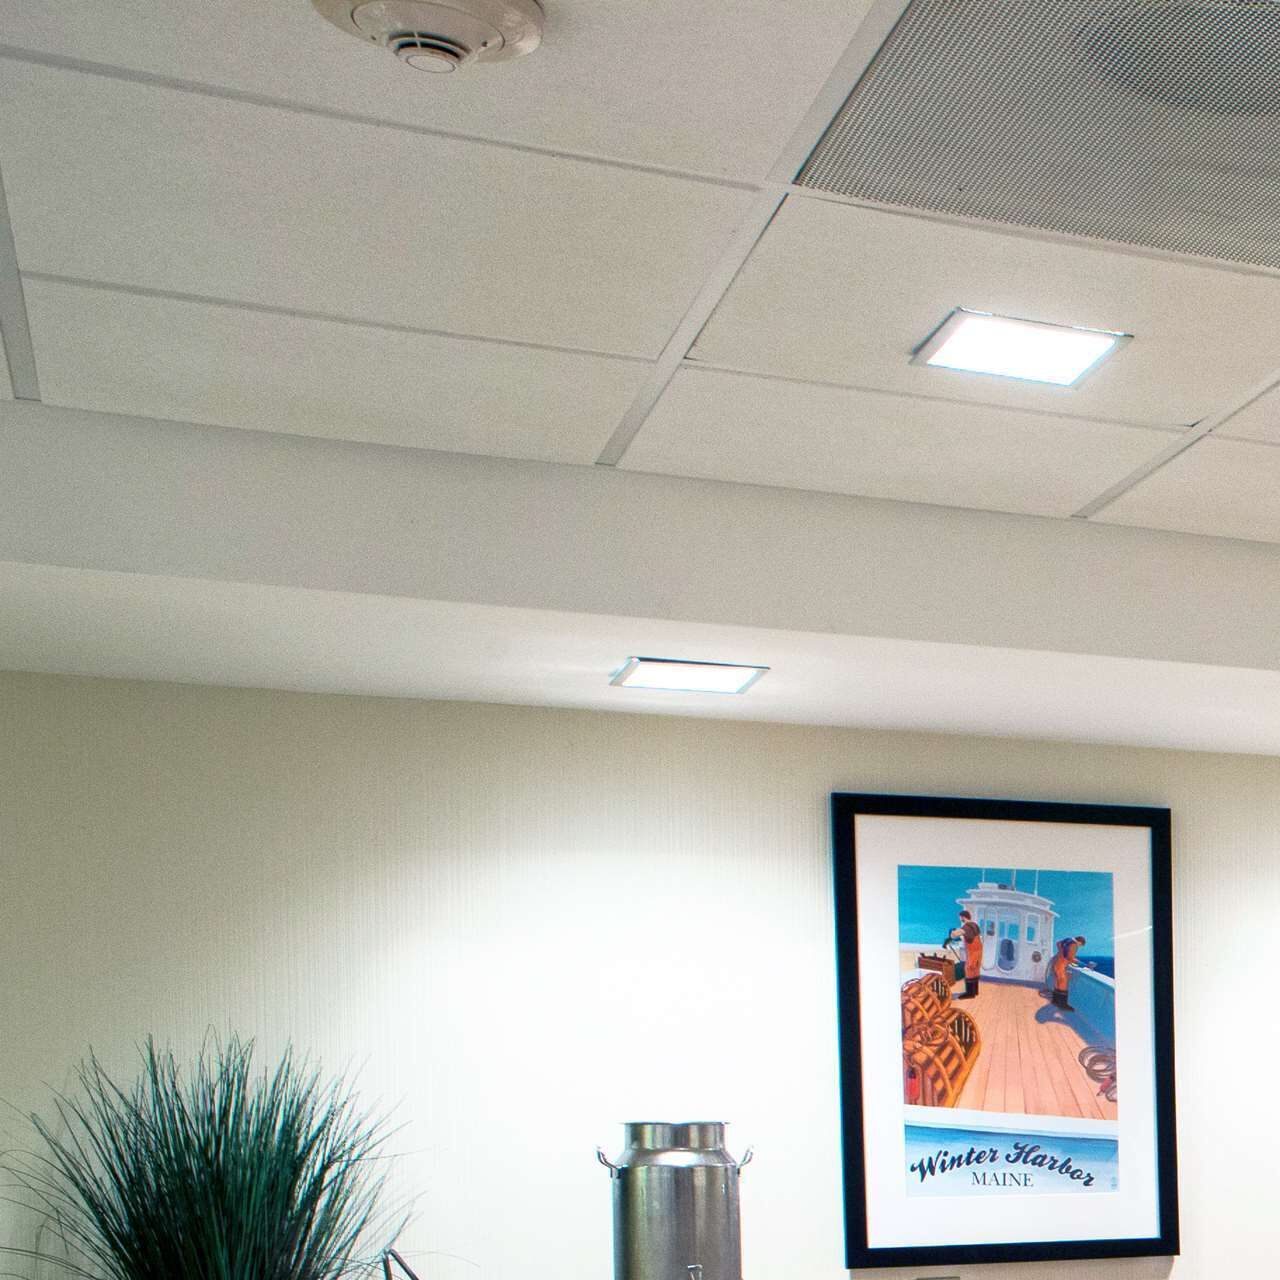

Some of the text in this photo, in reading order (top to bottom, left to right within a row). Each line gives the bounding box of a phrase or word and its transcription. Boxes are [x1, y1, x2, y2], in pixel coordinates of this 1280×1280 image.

[910, 1141, 1095, 1187] Winter Harbor
[971, 1171, 1034, 1187] MAINE
